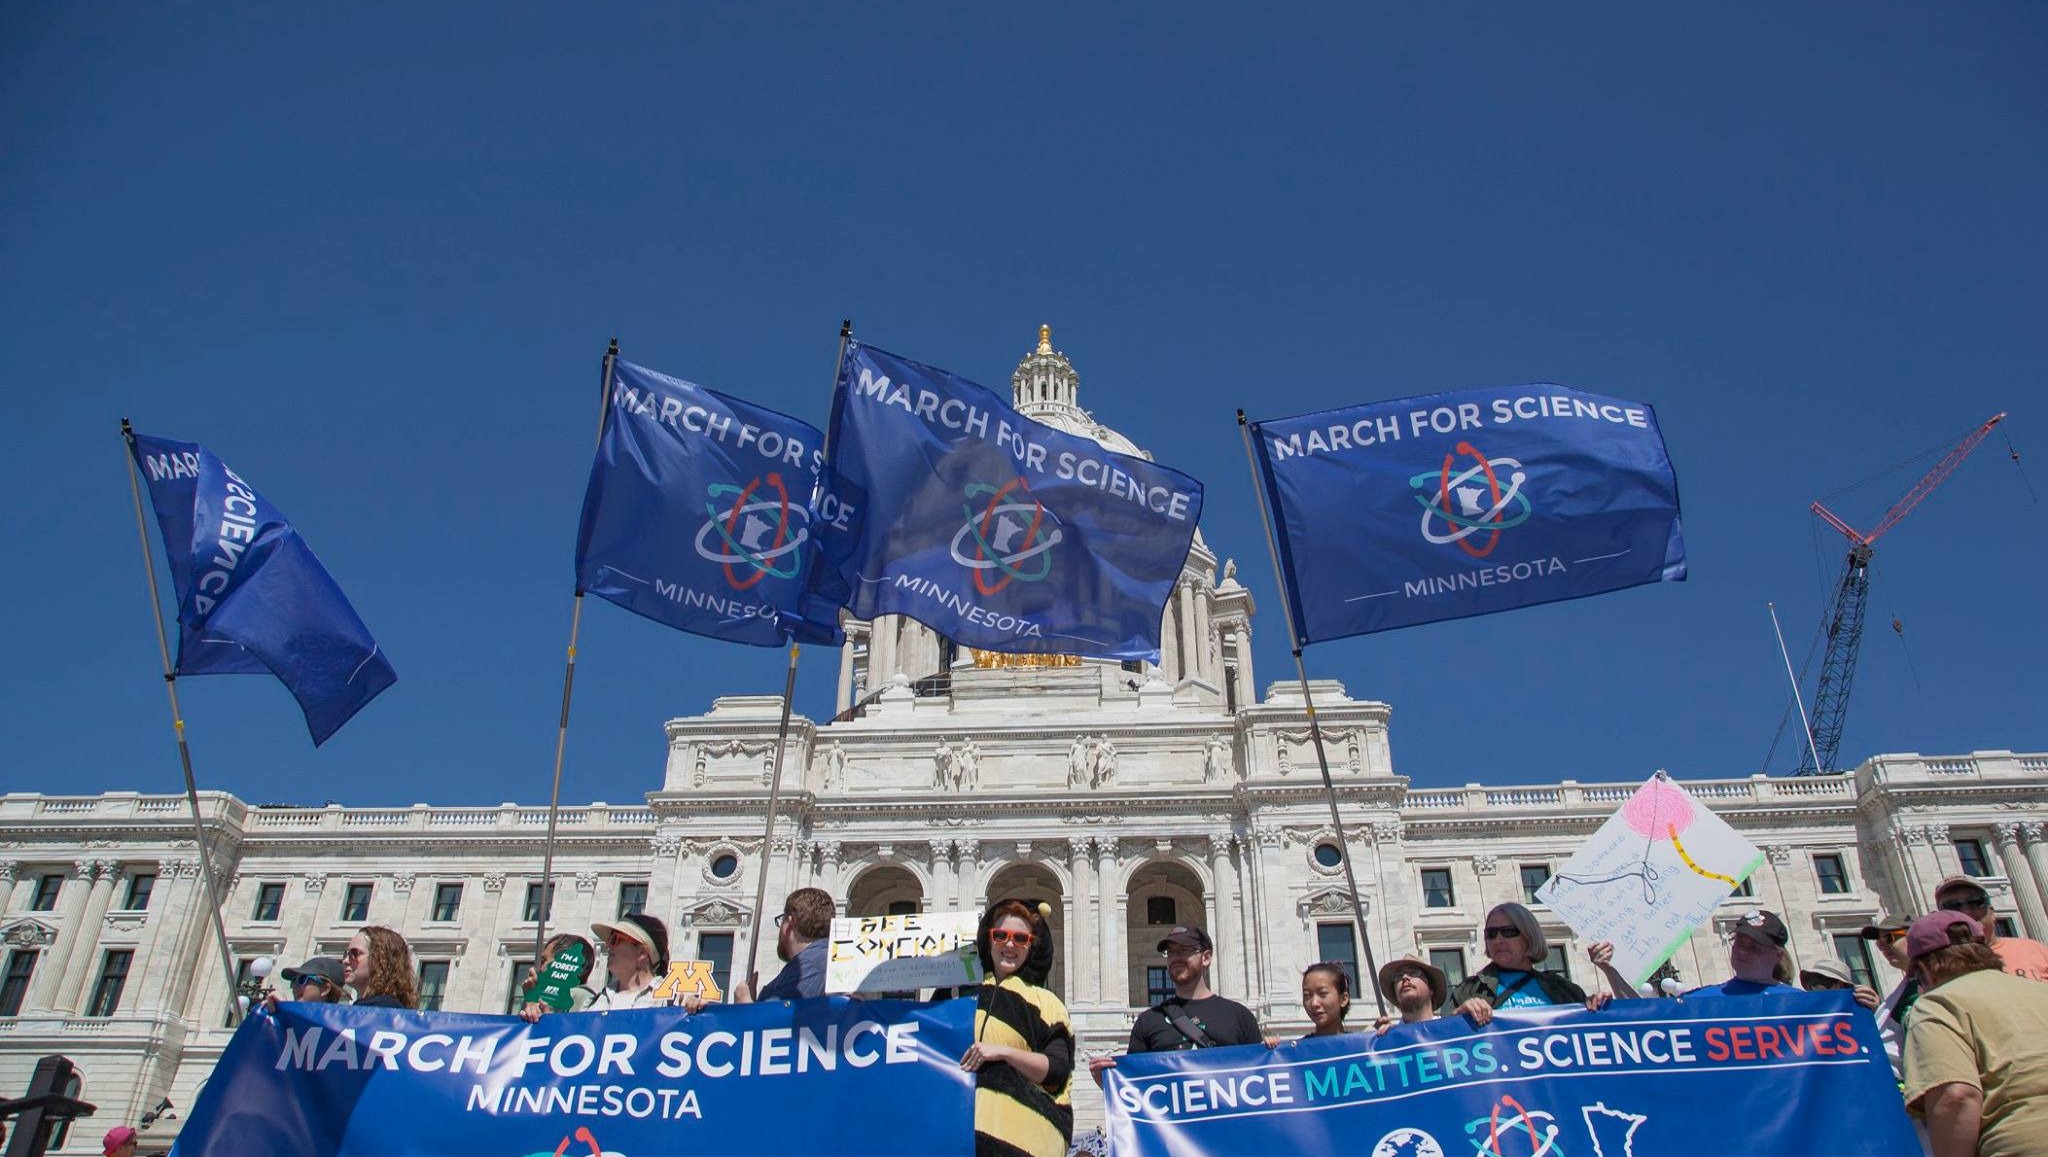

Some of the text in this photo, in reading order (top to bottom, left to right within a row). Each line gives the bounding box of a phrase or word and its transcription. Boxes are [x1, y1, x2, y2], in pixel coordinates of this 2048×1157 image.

[613, 382, 804, 467] MARCH FOR
[856, 369, 1190, 520] MARCH FOR SCIENCE
[1274, 396, 1647, 460] MARCH FOR SCIENCE
[146, 452, 200, 481] MAR
[1405, 557, 1566, 598] MINNESOTA
[656, 578, 778, 622] MINNESO
[896, 575, 1041, 637] MINNESOTA
[551, 961, 579, 971] FOREST
[551, 971, 568, 979] FAN!
[653, 961, 722, 1000] M
[276, 1022, 921, 1077] MARCH FOR SCIENCE
[1119, 1022, 1868, 1117] SCIENCE MATTERS. SCIENCE SERVES.
[467, 1084, 701, 1119] MINNESOTA
